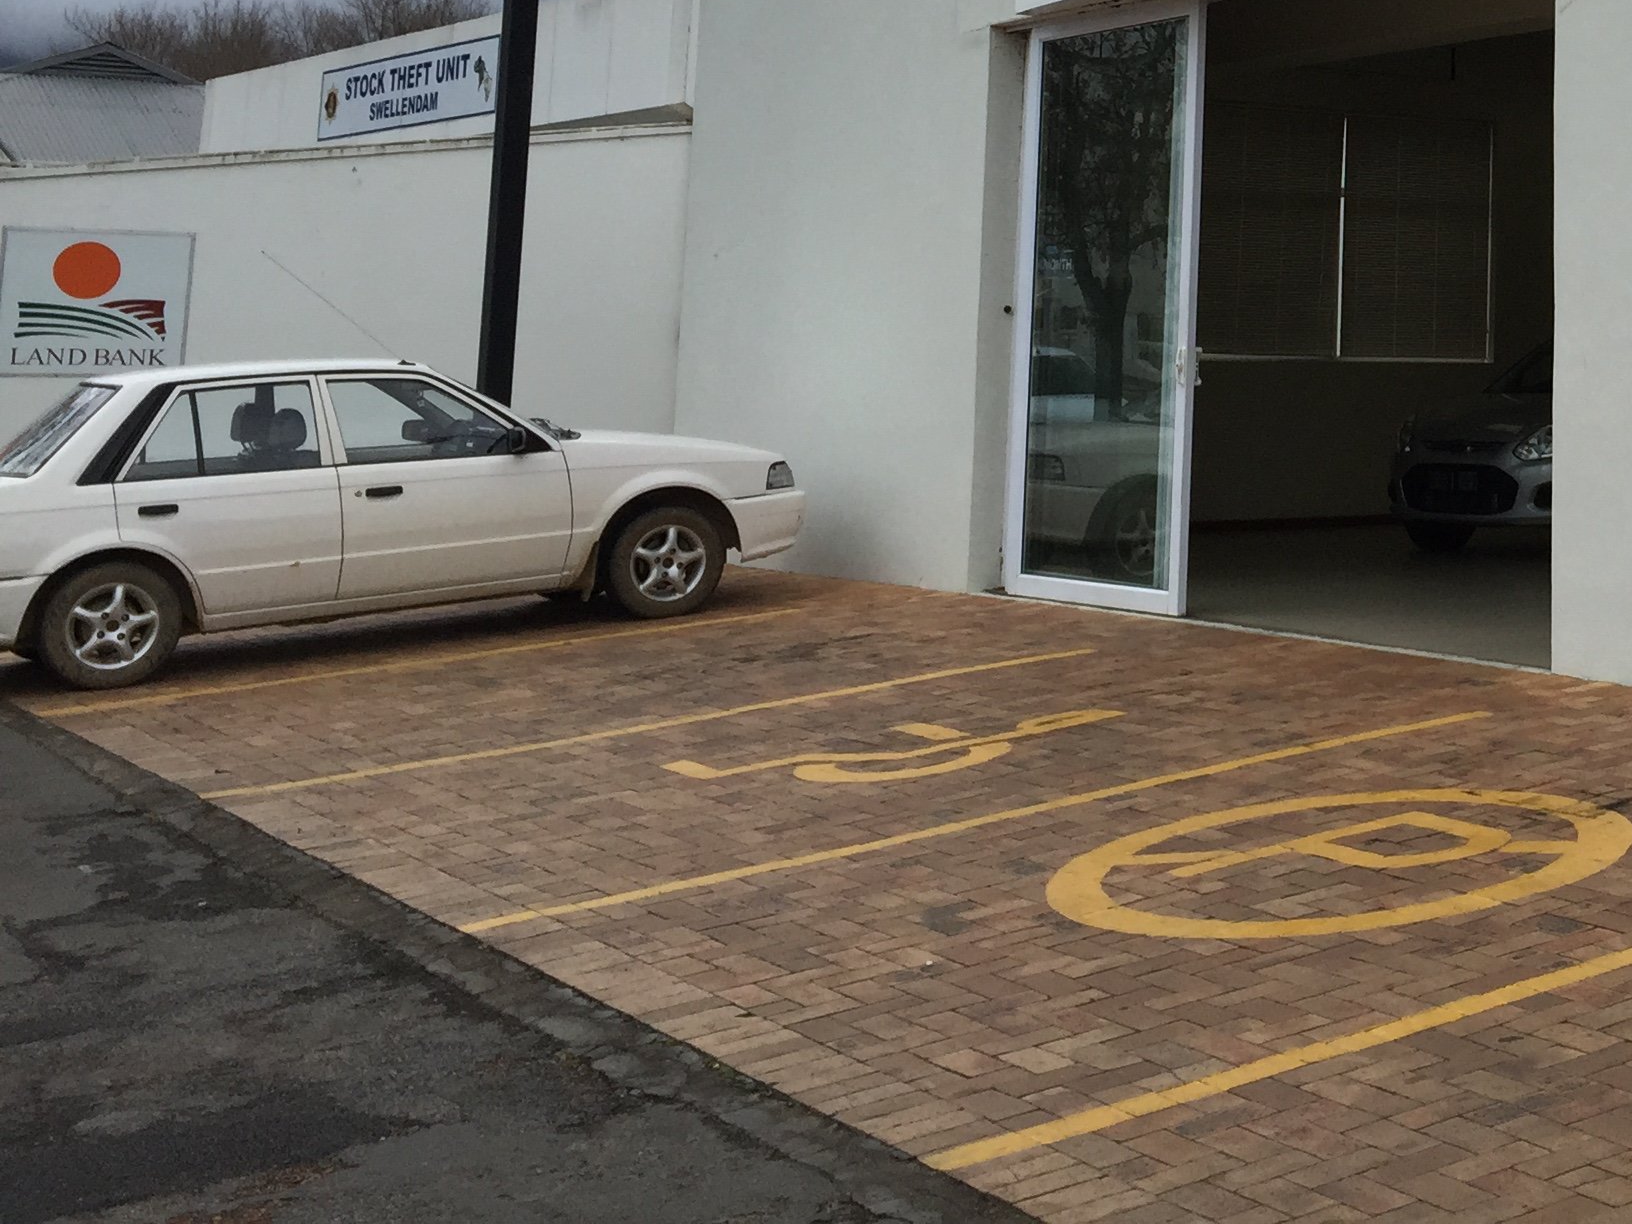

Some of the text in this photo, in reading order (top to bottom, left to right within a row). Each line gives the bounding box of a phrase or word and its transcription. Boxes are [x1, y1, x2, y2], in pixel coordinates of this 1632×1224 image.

[345, 53, 471, 101] STOCK THEFT UNIT
[369, 91, 439, 121] SWELLENDAM
[10, 347, 167, 367] LAND BANK
